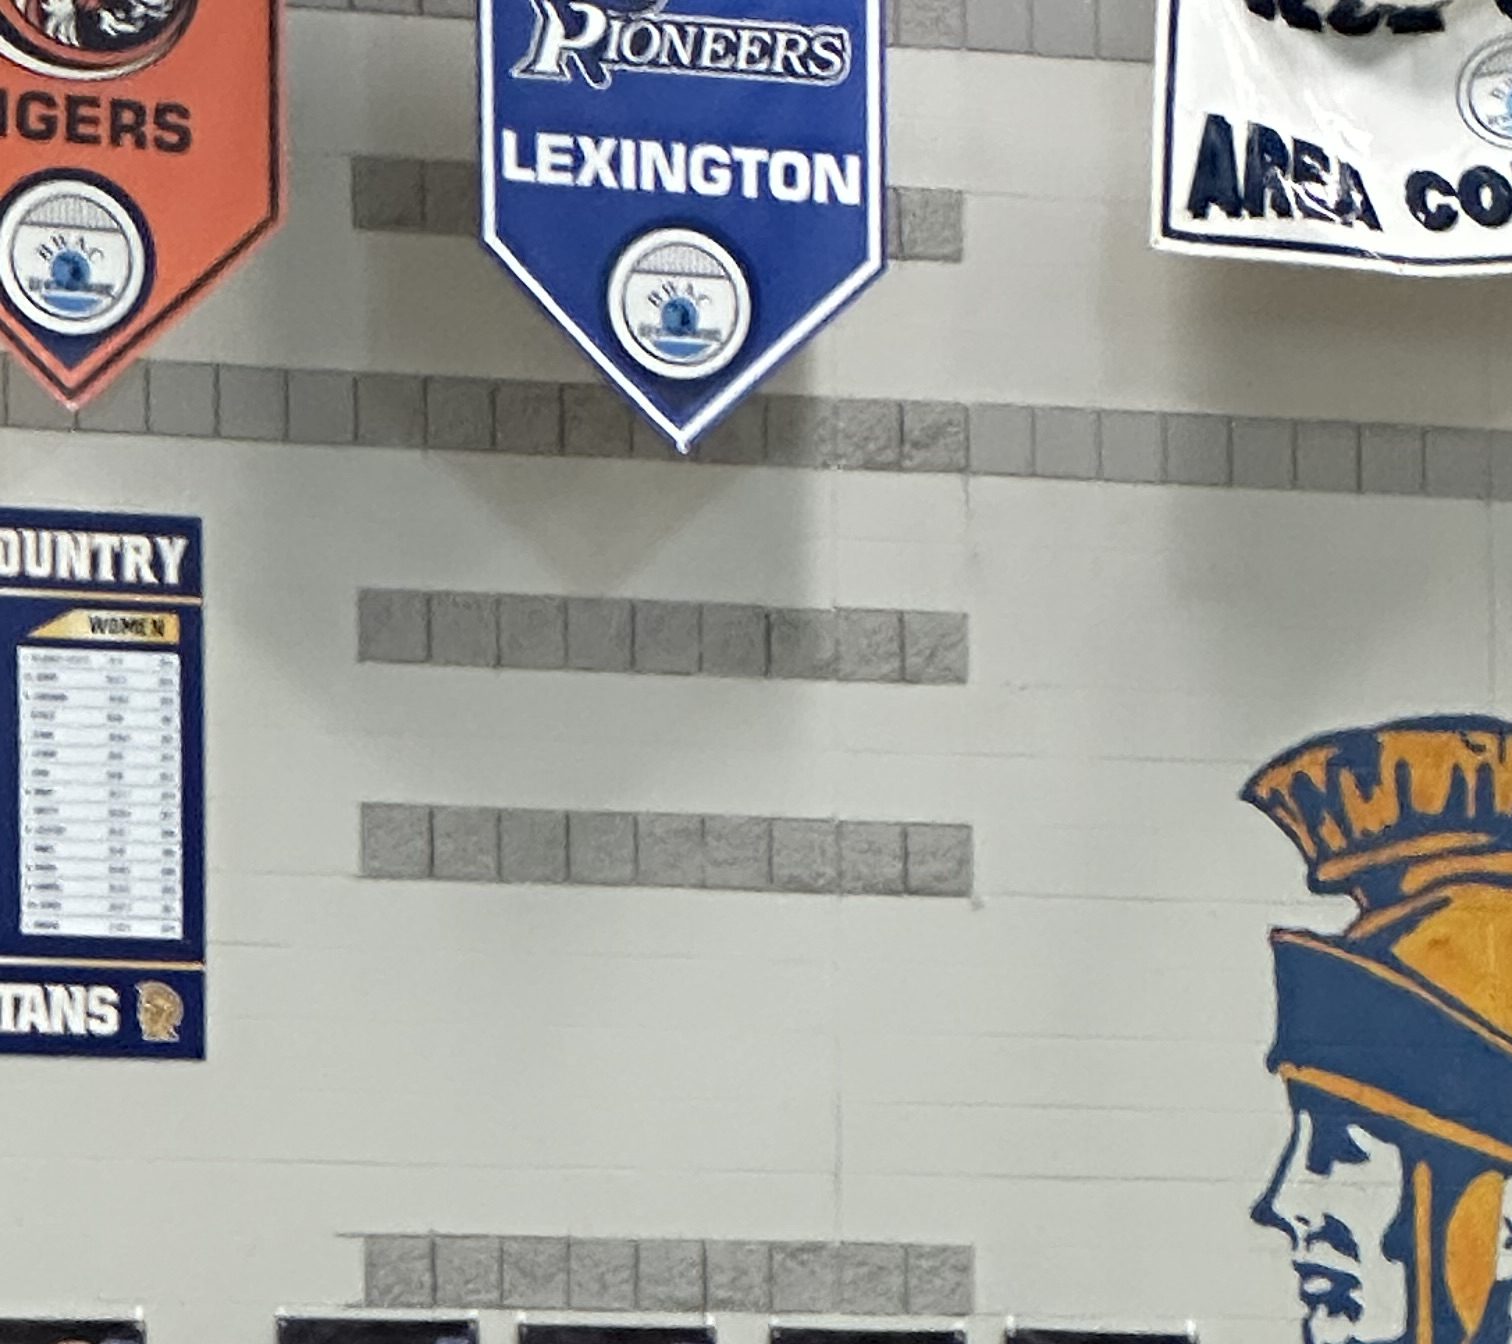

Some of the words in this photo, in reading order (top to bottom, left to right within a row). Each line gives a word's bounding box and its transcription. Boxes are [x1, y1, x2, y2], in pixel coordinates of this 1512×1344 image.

[530, 0, 846, 82] PIONEERS
[502, 128, 861, 206] LEXINGTON
[1186, 113, 1384, 231] AREA
[88, 616, 165, 637] WOMEN
